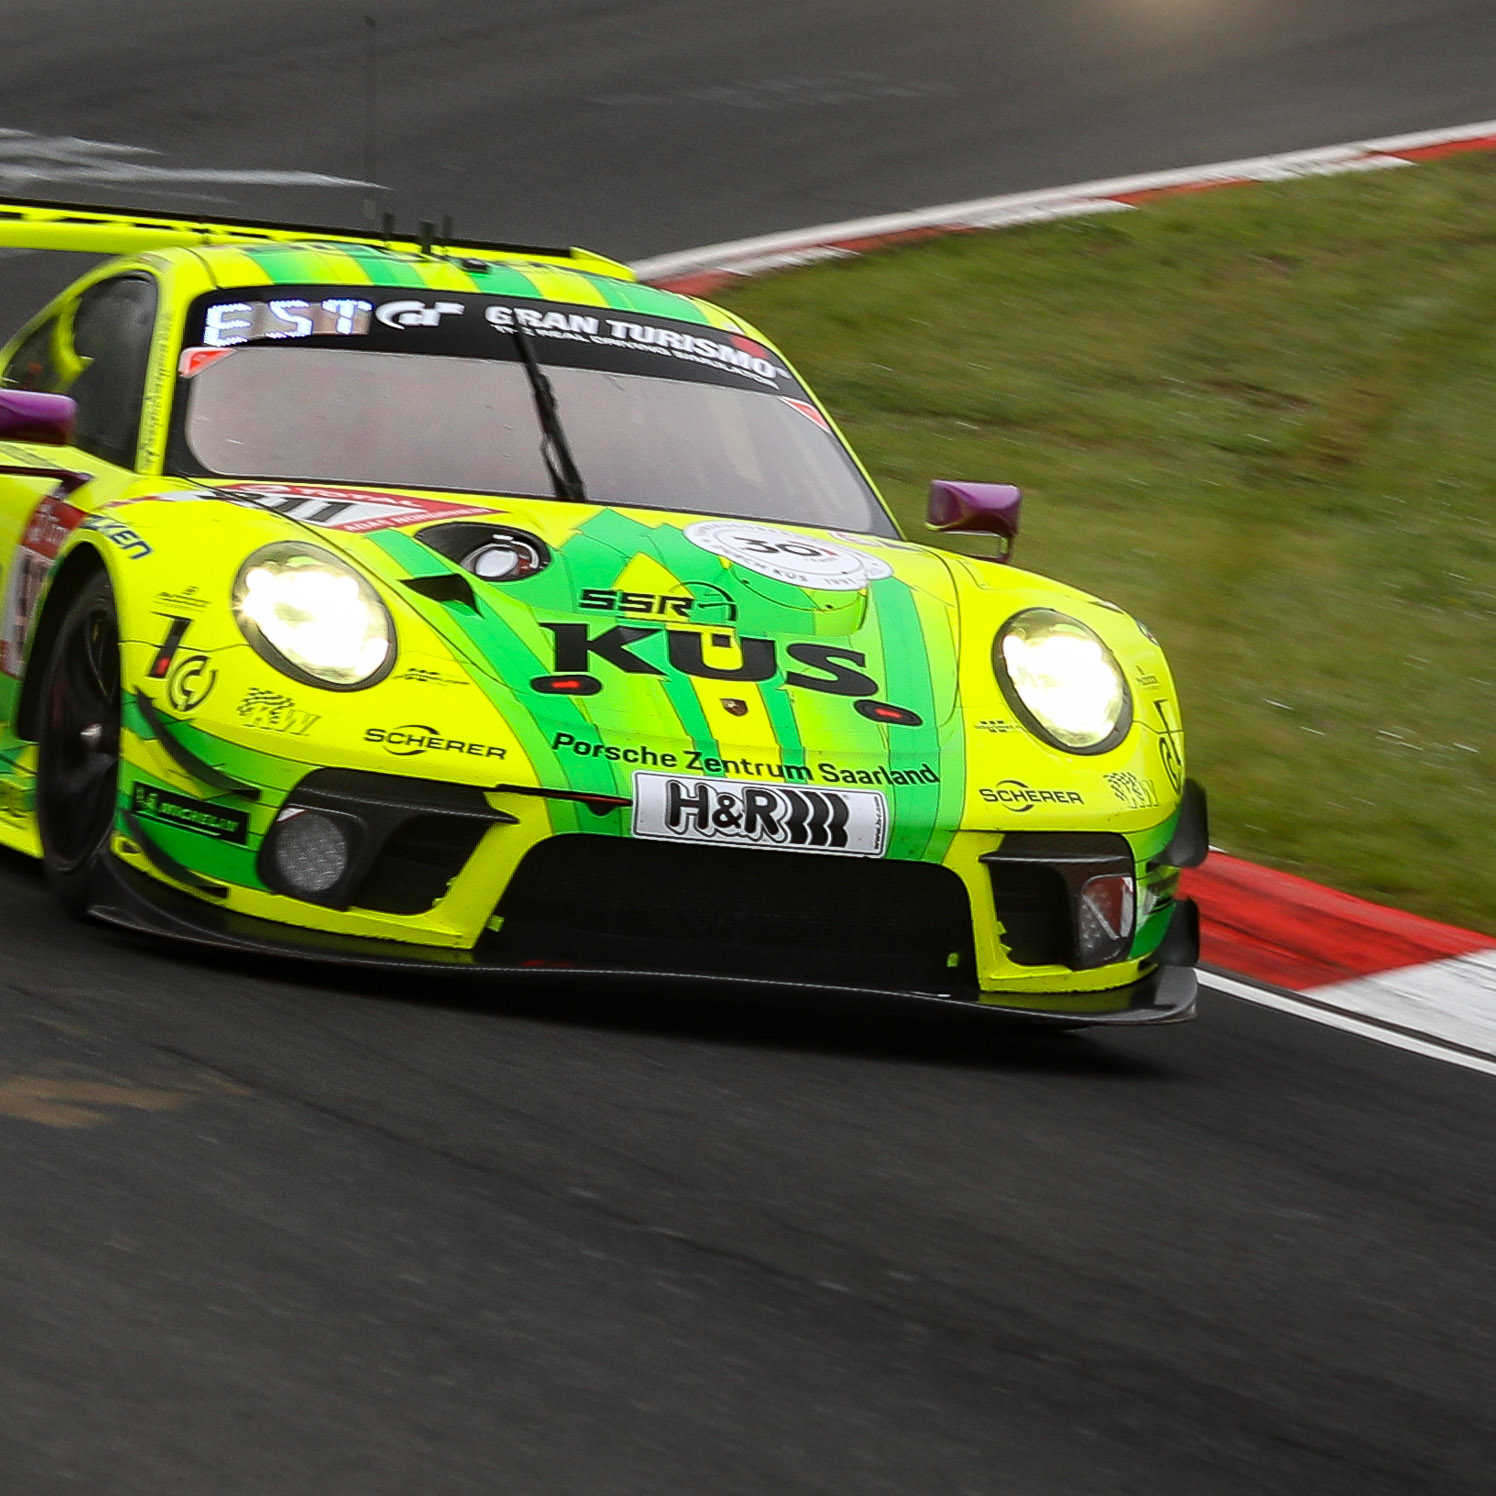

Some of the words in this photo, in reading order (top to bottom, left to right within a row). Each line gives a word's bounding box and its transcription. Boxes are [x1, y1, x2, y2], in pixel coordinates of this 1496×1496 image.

[485, 306, 600, 335] GRAN
[606, 319, 778, 380] TURISMO
[579, 589, 695, 618] SSR
[538, 621, 879, 697] KÜS
[363, 727, 508, 761] SCHERER
[552, 731, 678, 769] Porsche
[687, 750, 815, 782] Zentrum
[818, 762, 941, 786] Saarland
[664, 779, 789, 844] H&R
[978, 787, 1085, 805] SCHERER
